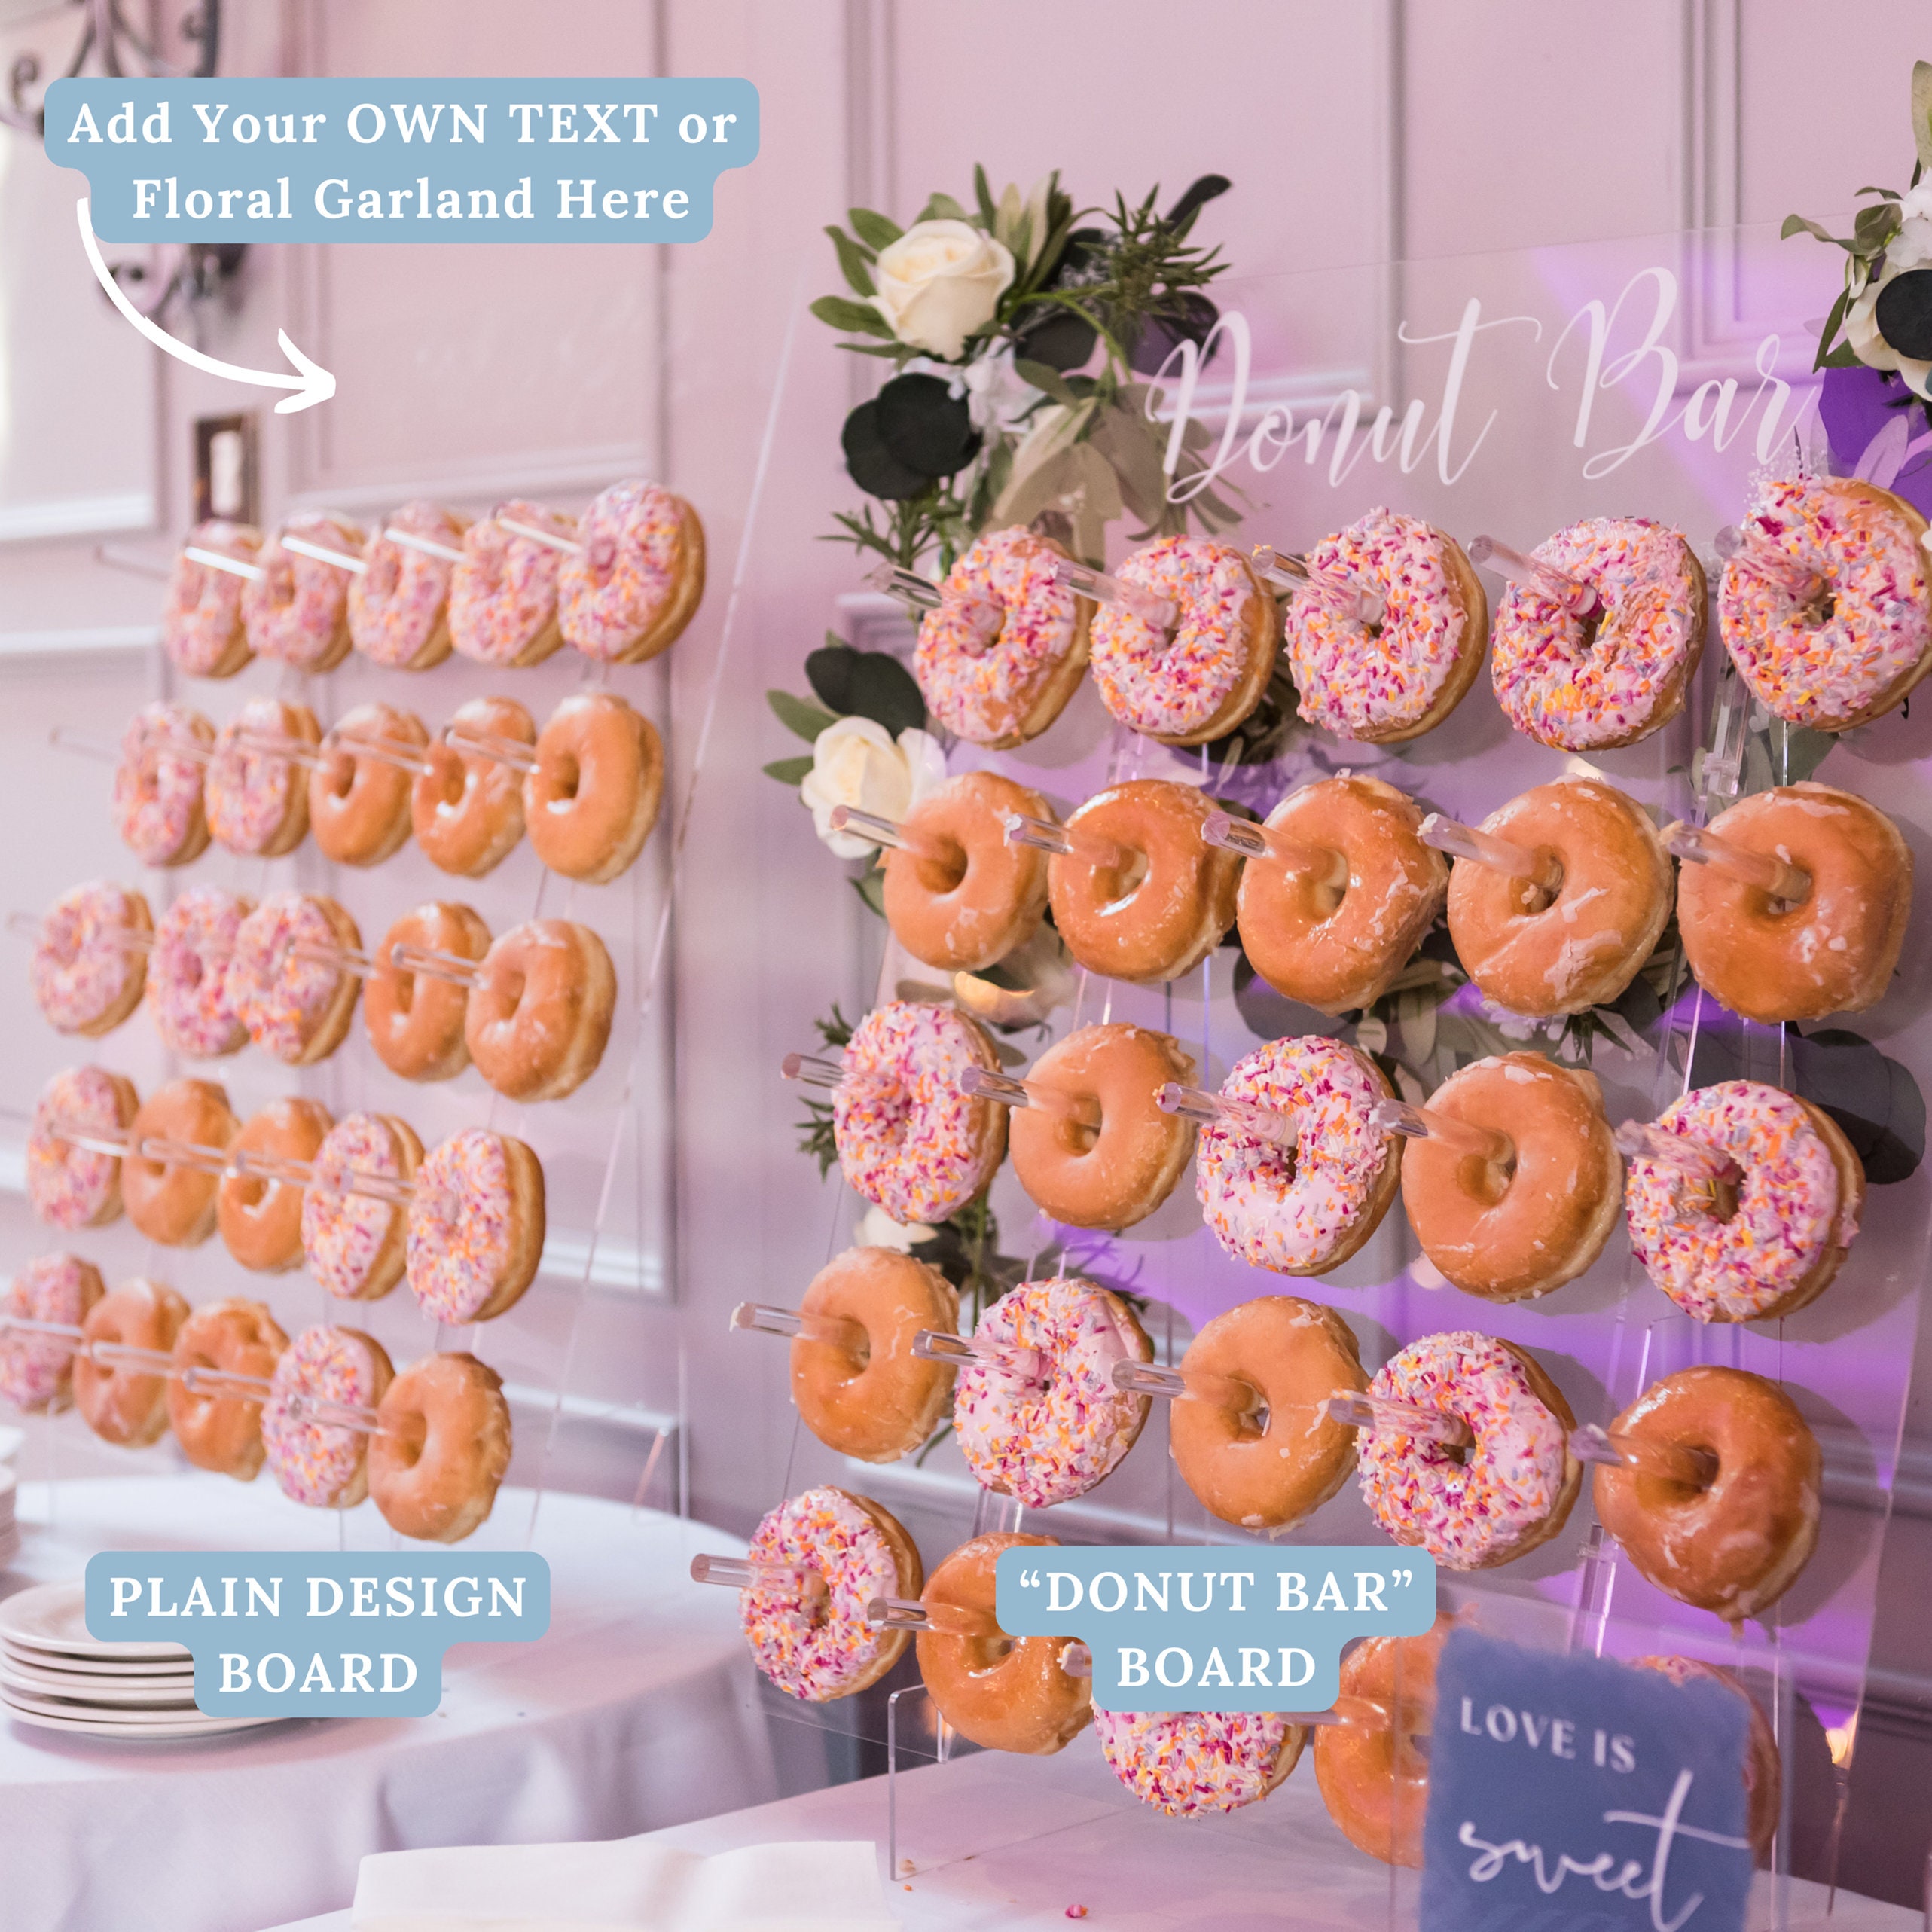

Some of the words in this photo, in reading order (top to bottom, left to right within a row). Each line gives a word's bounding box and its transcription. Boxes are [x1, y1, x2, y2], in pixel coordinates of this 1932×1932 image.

[1145, 297, 1543, 504] Donut
[1546, 267, 1817, 480] Bar
[1460, 1696, 1576, 1760] LOVE
[1592, 1729, 1636, 1773] IS
[1458, 1769, 1751, 1932] sweet
